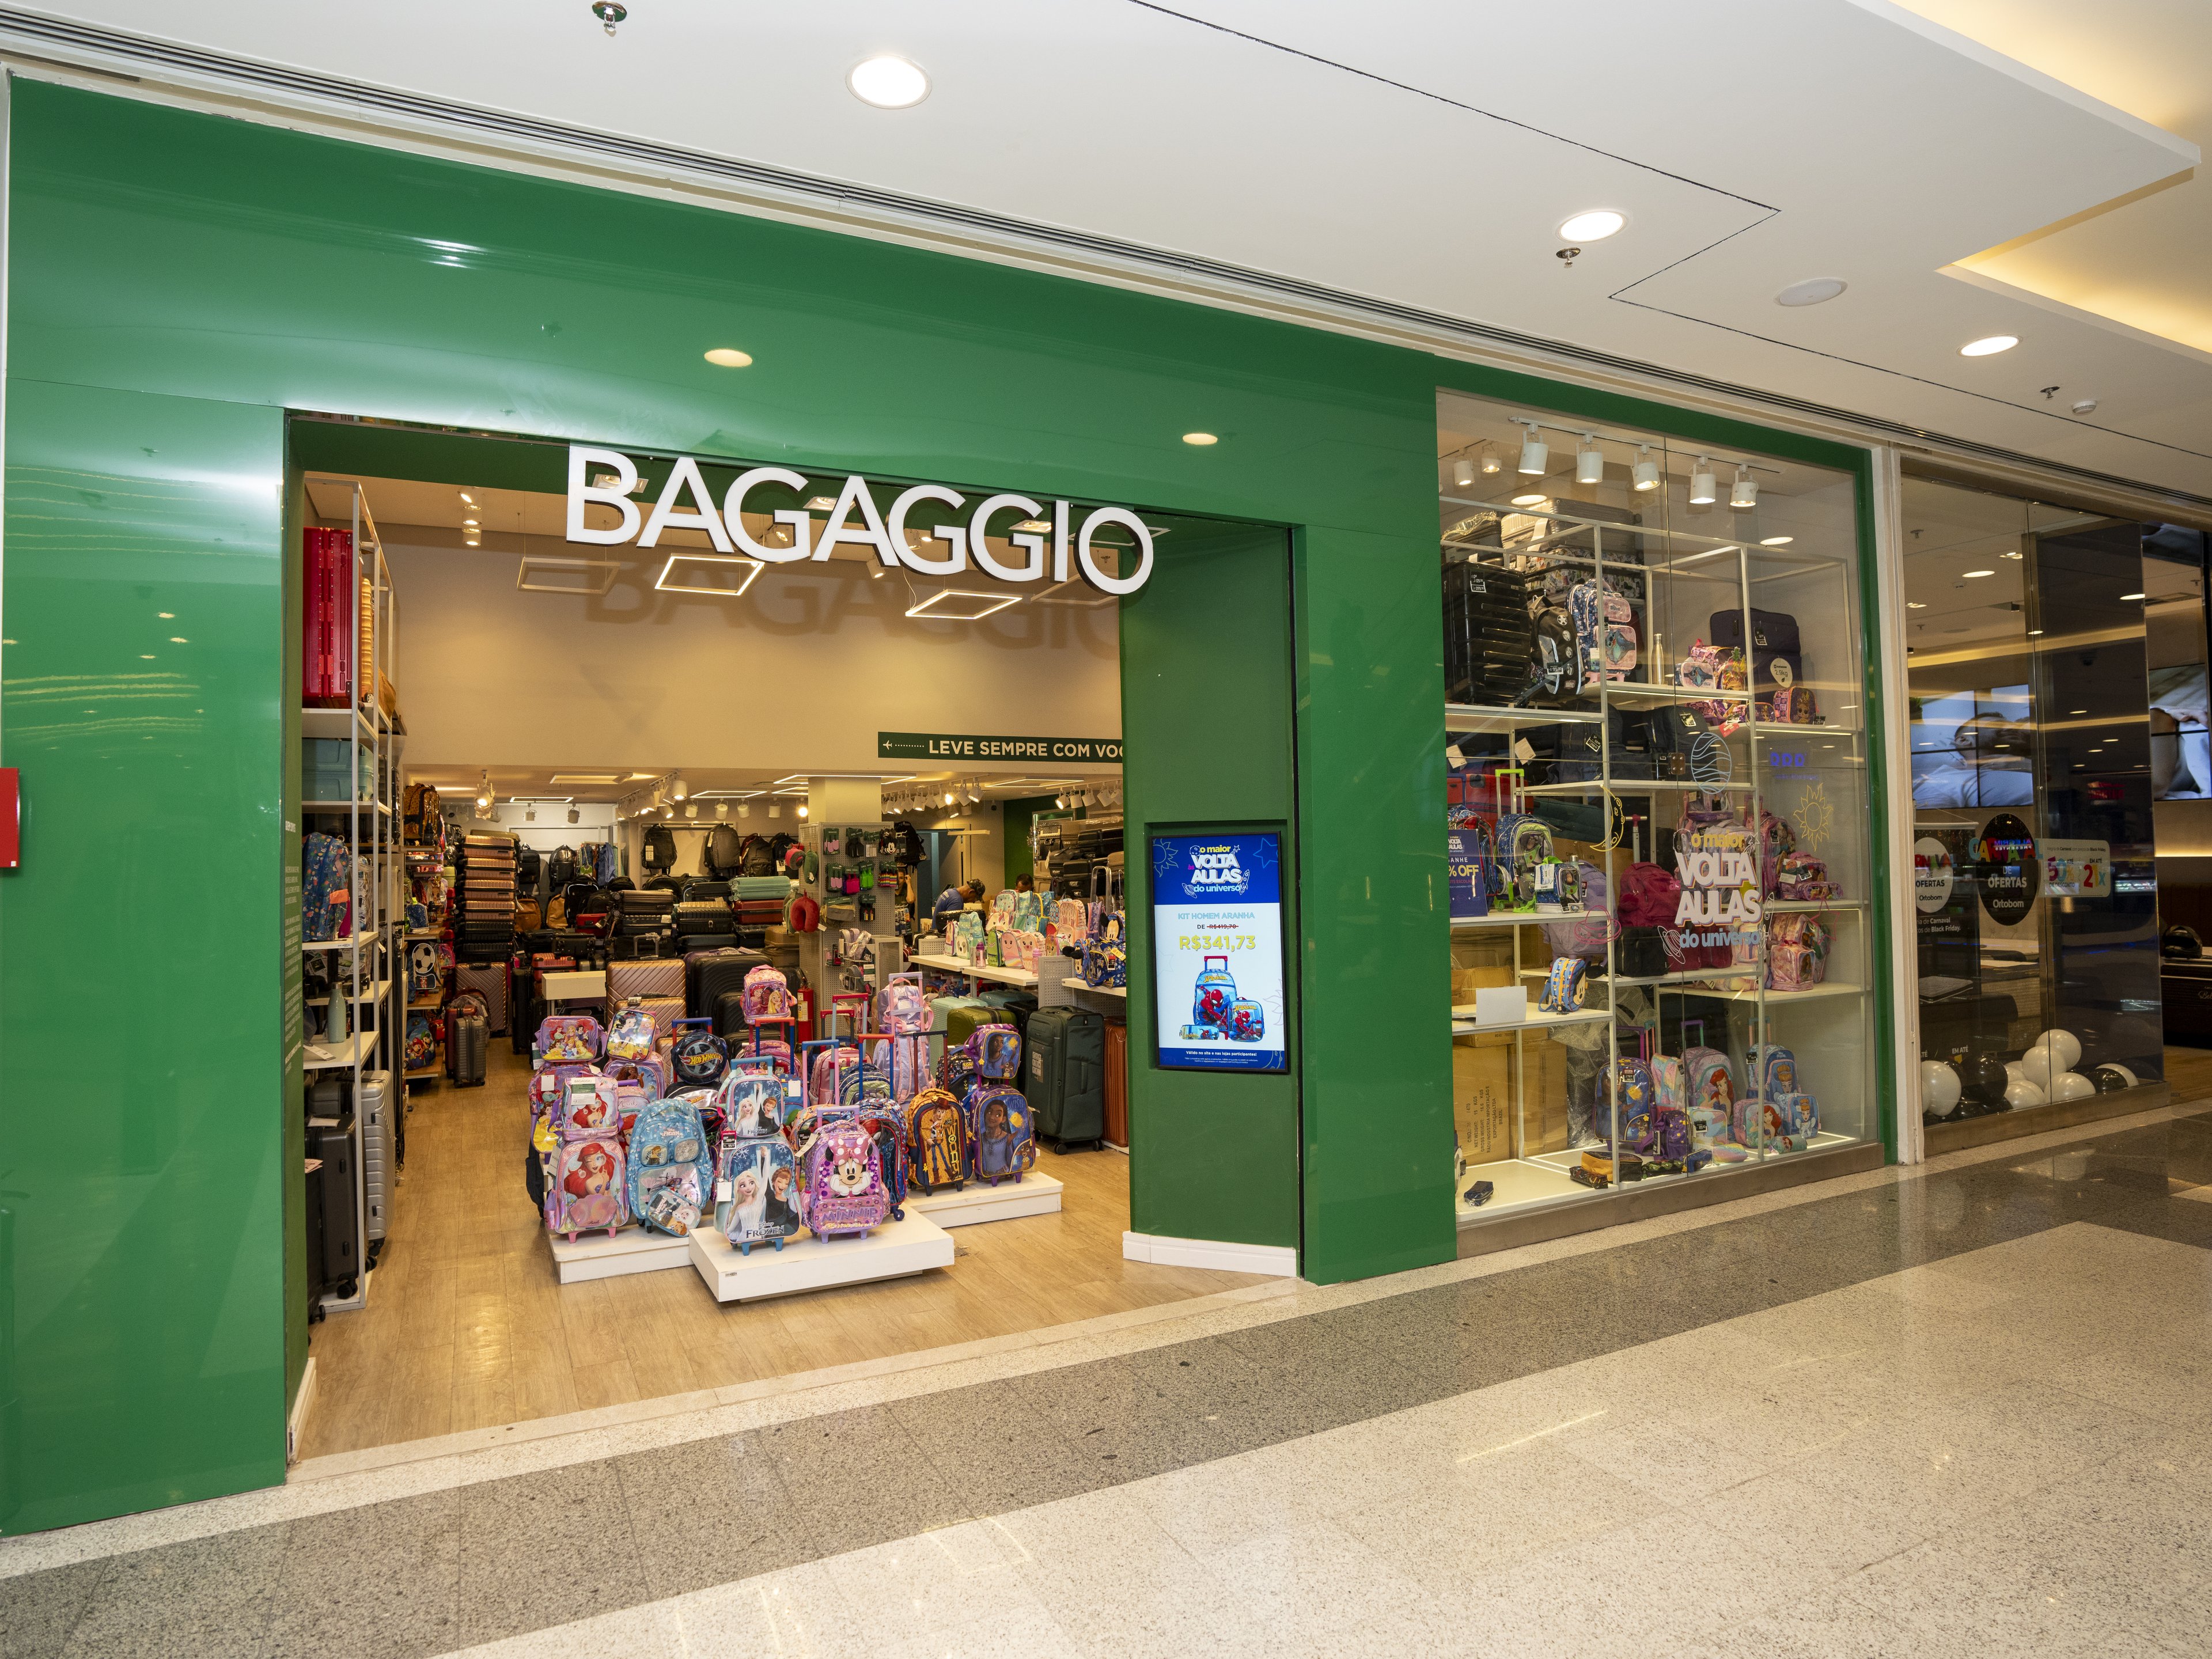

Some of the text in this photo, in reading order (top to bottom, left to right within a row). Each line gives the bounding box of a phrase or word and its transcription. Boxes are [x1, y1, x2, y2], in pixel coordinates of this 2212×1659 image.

[566, 445, 1153, 596] BAGAGGIO
[929, 740, 974, 755] LEVE
[979, 741, 1048, 756] SEMPRE
[1053, 743, 1090, 757] COM
[1691, 830, 1745, 848] o maior
[1207, 844, 1231, 853] maior
[1191, 853, 1240, 869] VOLTA
[1191, 868, 1243, 884] AULAS
[1458, 865, 1479, 877] OFF
[1675, 852, 1760, 889] VOLTA
[2002, 866, 2012, 874] DE
[1194, 884, 1241, 893] do universo
[1915, 880, 1945, 888] OFERTAS
[1987, 877, 2028, 888] OFERTAS
[1674, 889, 1763, 928] AULAS
[1993, 899, 2024, 908] Ortobom
[1179, 934, 1256, 952] R$341,73
[1679, 927, 1761, 948] do universo
[691, 1055, 702, 1065] HOT
[821, 1206, 877, 1222] MINNIE
[746, 1225, 785, 1238] FROZEN
